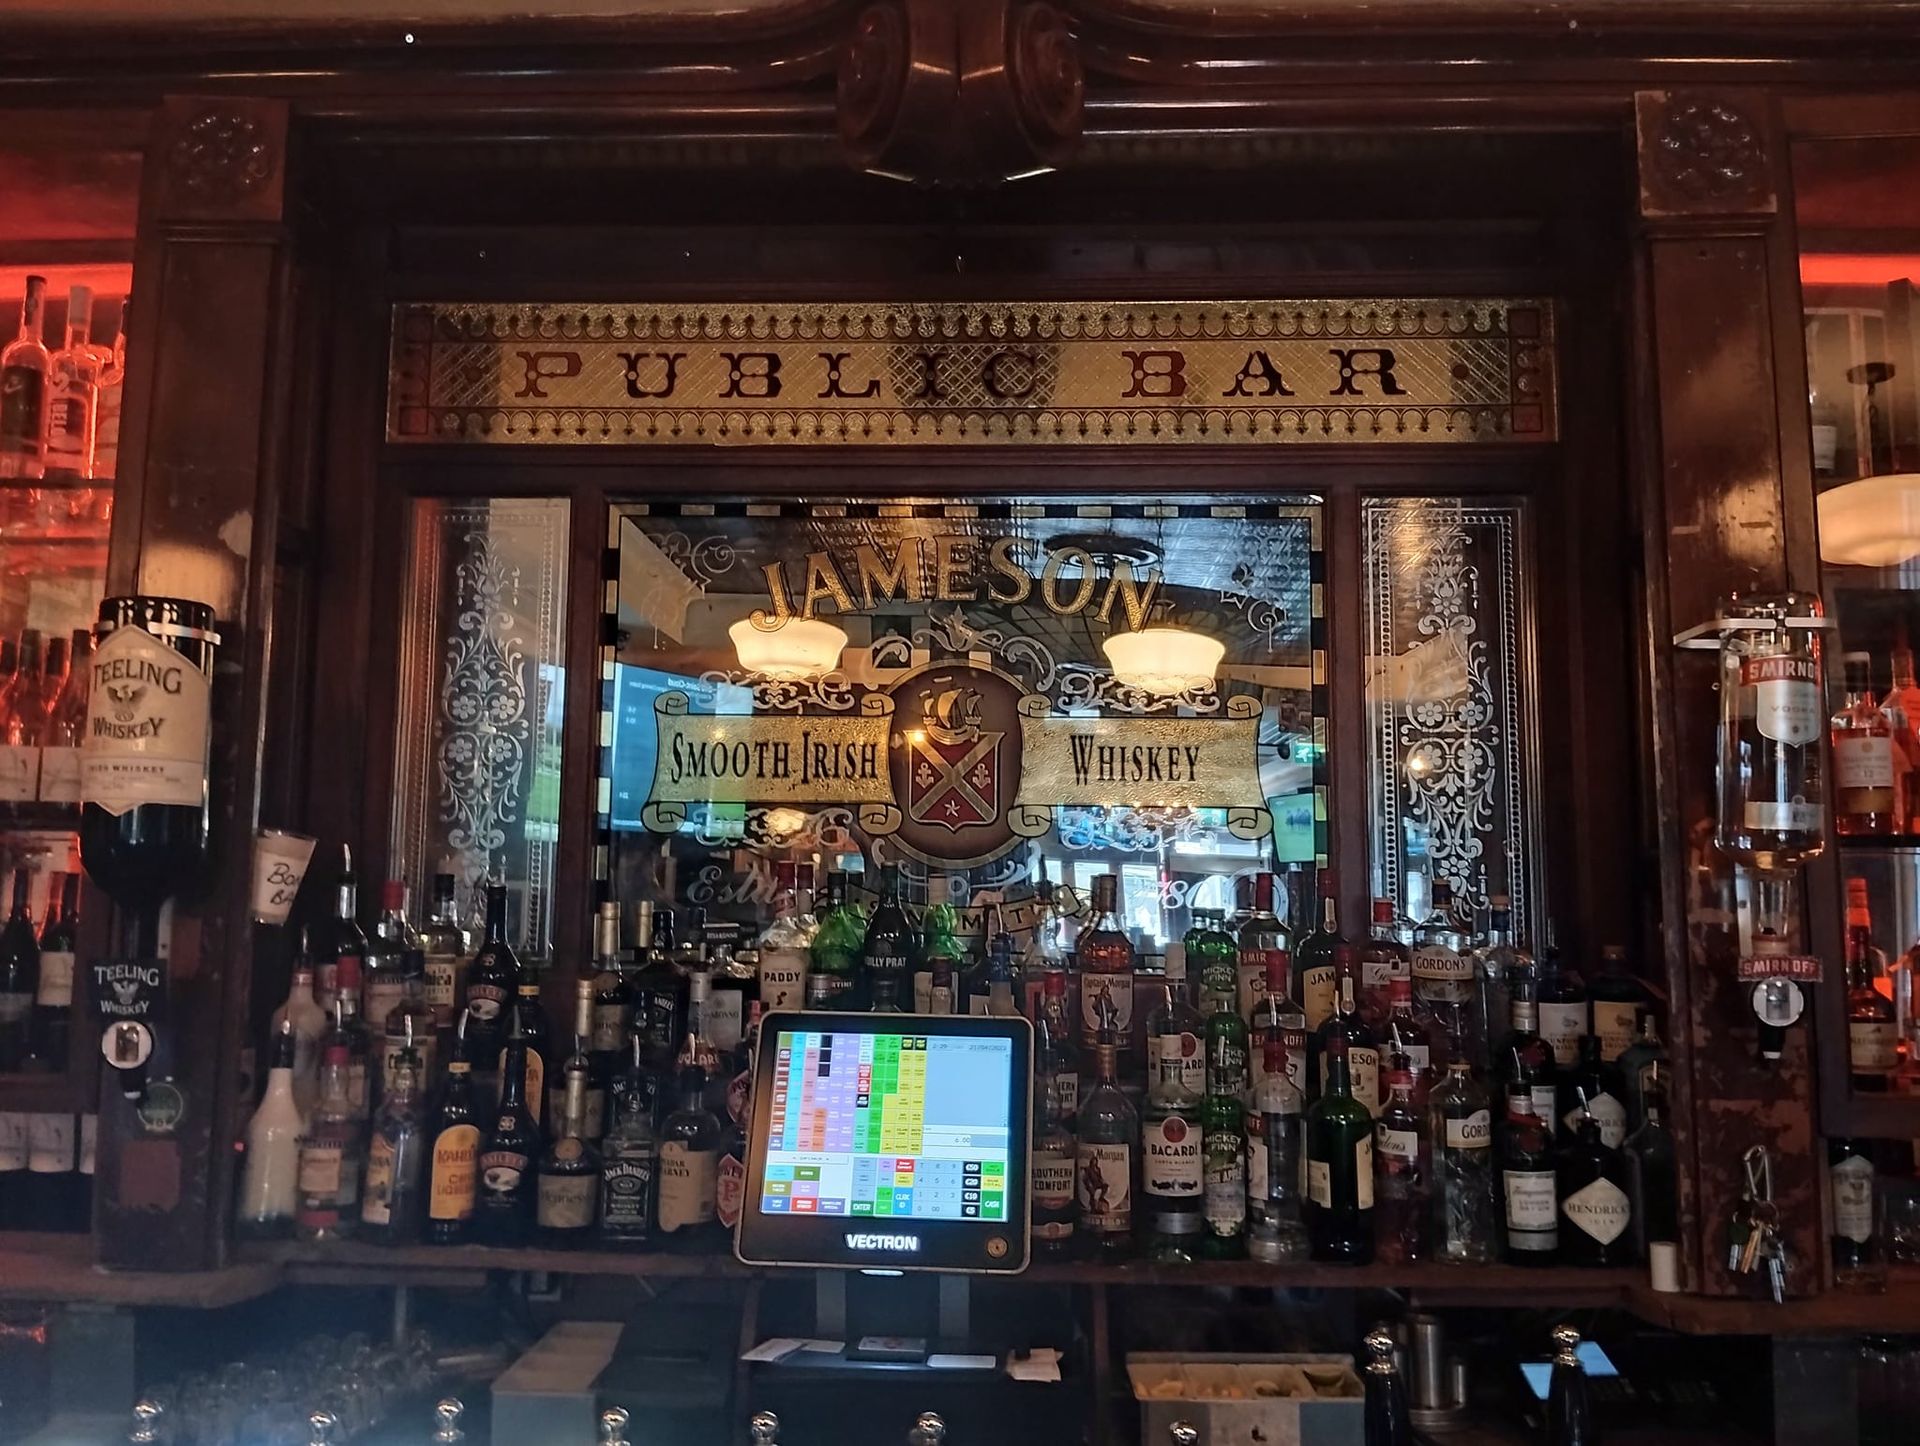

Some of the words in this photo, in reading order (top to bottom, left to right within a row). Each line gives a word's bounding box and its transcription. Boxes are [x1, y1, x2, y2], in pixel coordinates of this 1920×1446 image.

[514, 350, 1036, 399] PUBLIC
[1121, 349, 1407, 397] BAR
[747, 532, 1163, 634] JAMESON
[94, 659, 183, 694] TEELING
[1749, 661, 1814, 679] SMIRNO
[93, 716, 164, 739] WHISKEY
[668, 730, 791, 785] SMOOTH
[800, 730, 878, 785] IRISH
[1070, 733, 1201, 786] WHISKEY
[112, 765, 165, 773] WHISKEY
[1202, 965, 1235, 977] MICKEY
[1743, 958, 1817, 974] SMIRNOFF
[94, 964, 159, 986] TEELING
[763, 971, 801, 982] PADDY
[1208, 973, 1232, 983] FINN
[99, 1000, 150, 1015] WHISKEY
[1205, 1134, 1241, 1145] MICKEY
[1210, 1142, 1236, 1152] FINN
[1034, 1180, 1071, 1191] COMFORT
[1567, 1202, 1627, 1215] HENDRICK
[846, 1233, 919, 1252] VECTRON
